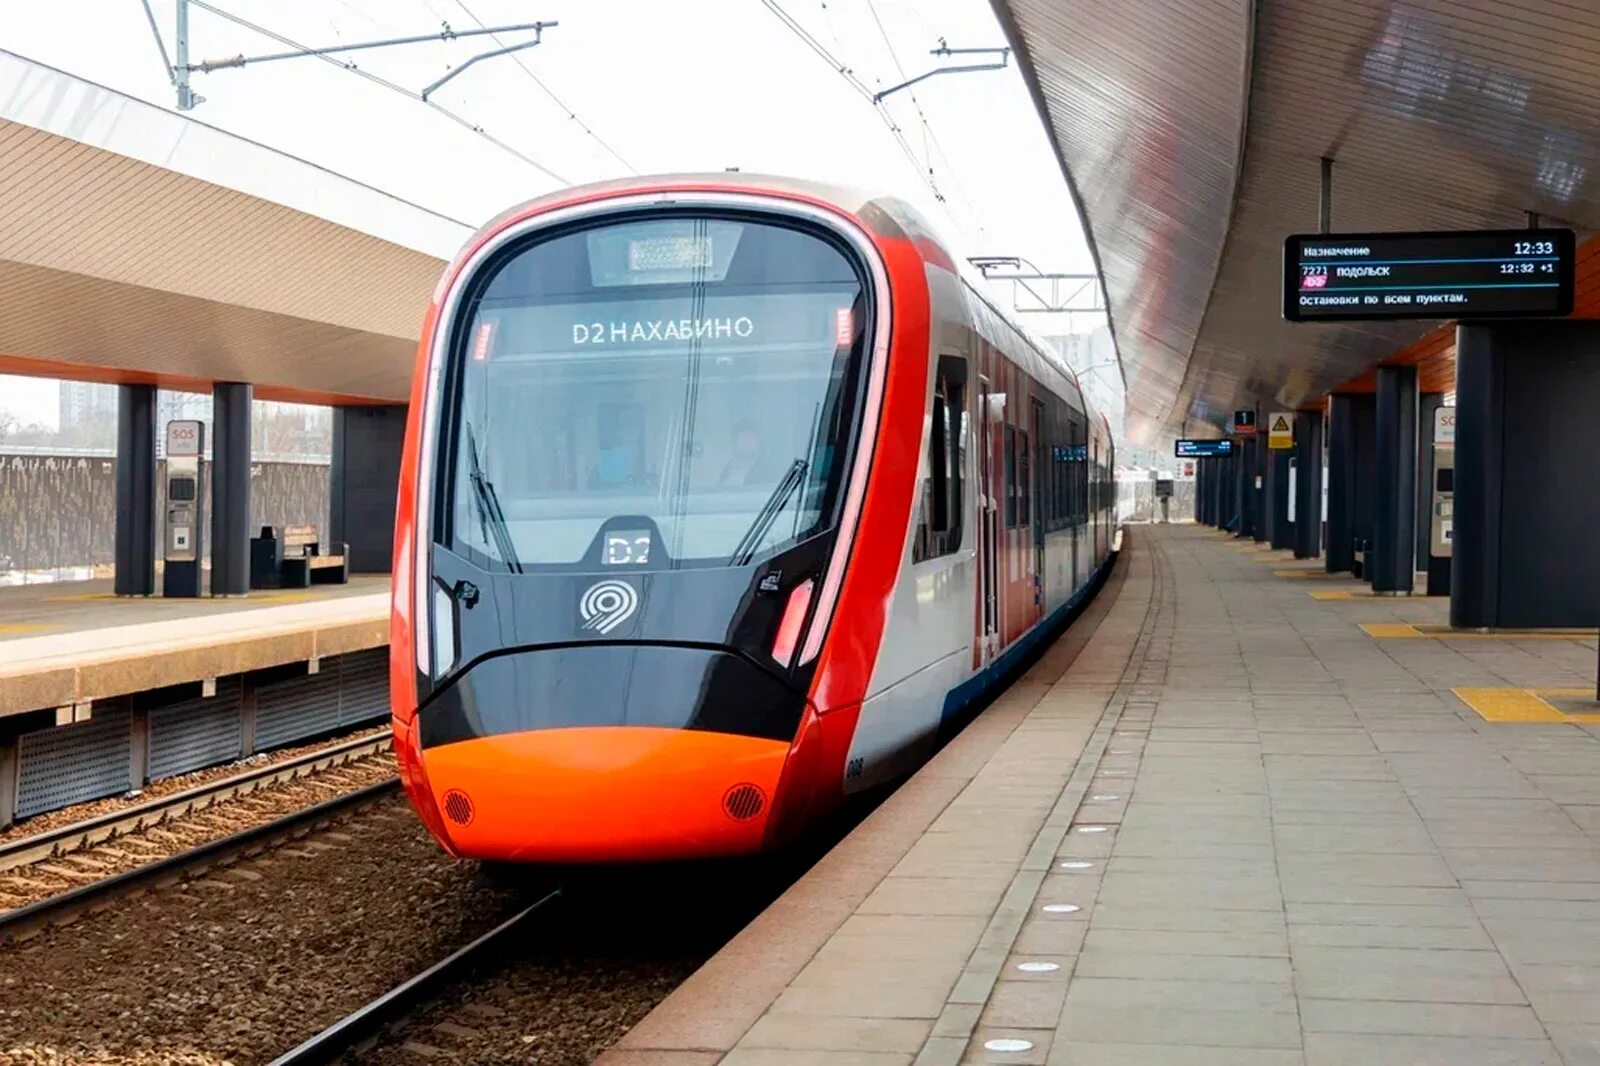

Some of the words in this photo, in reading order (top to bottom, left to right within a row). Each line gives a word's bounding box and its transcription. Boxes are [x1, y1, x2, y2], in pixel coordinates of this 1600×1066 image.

[1303, 247, 1370, 257] Назначение
[1514, 242, 1553, 255] 12:33
[1336, 266, 1390, 278] ПОДОЛЬСК
[1500, 263, 1535, 274] 12:32
[1540, 263, 1554, 273] +1
[1299, 296, 1359, 306] Остановки
[1364, 296, 1378, 305] по
[1384, 295, 1411, 304] всем
[1416, 293, 1469, 306] пунктам.
[572, 323, 605, 345] D2
[610, 316, 754, 342] НАХАБИНО
[1440, 415, 1456, 426] SO
[172, 429, 194, 440] SOS
[608, 537, 650, 564] D2
